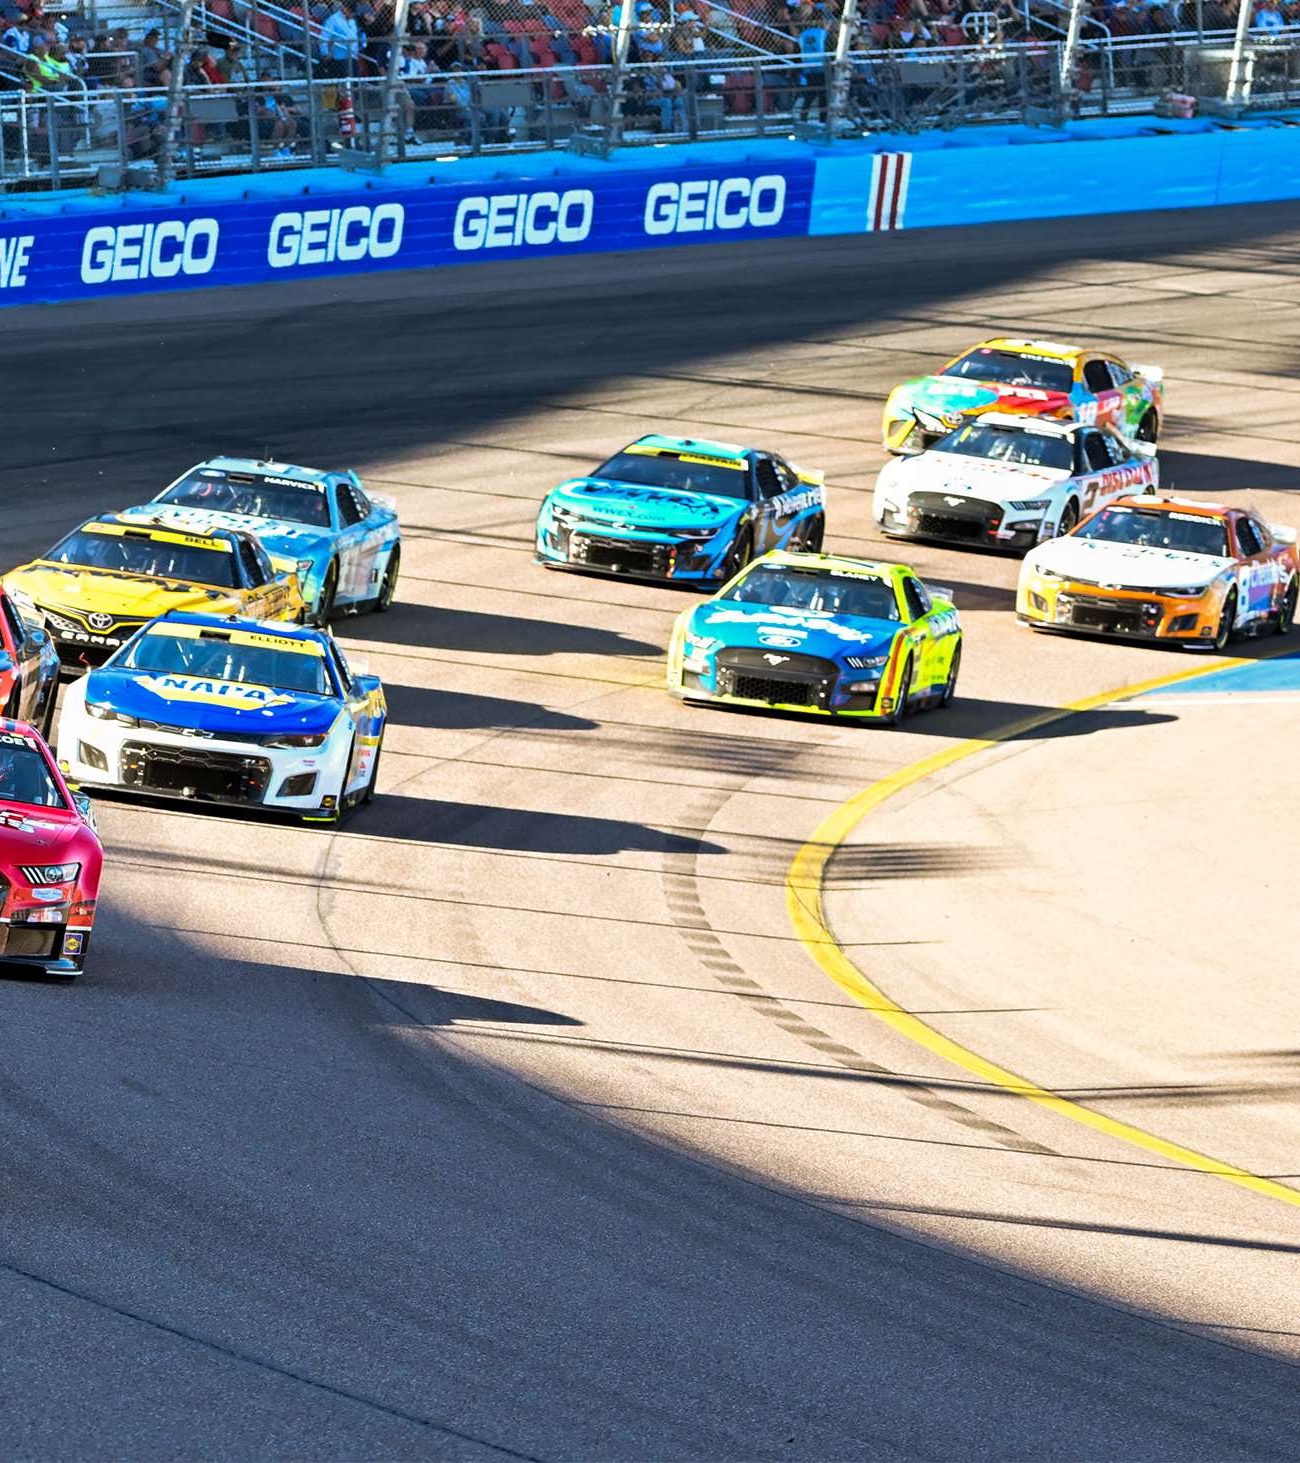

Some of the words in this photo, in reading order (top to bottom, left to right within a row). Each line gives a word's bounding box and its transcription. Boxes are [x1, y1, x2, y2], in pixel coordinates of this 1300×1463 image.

[454, 190, 593, 250] GEICO
[645, 175, 786, 234] GEICO
[81, 219, 219, 284] GEICO
[268, 203, 404, 267] GEICO
[184, 535, 219, 548] BELL
[249, 633, 307, 649] ELLIOTT
[162, 677, 267, 702] NAPA
